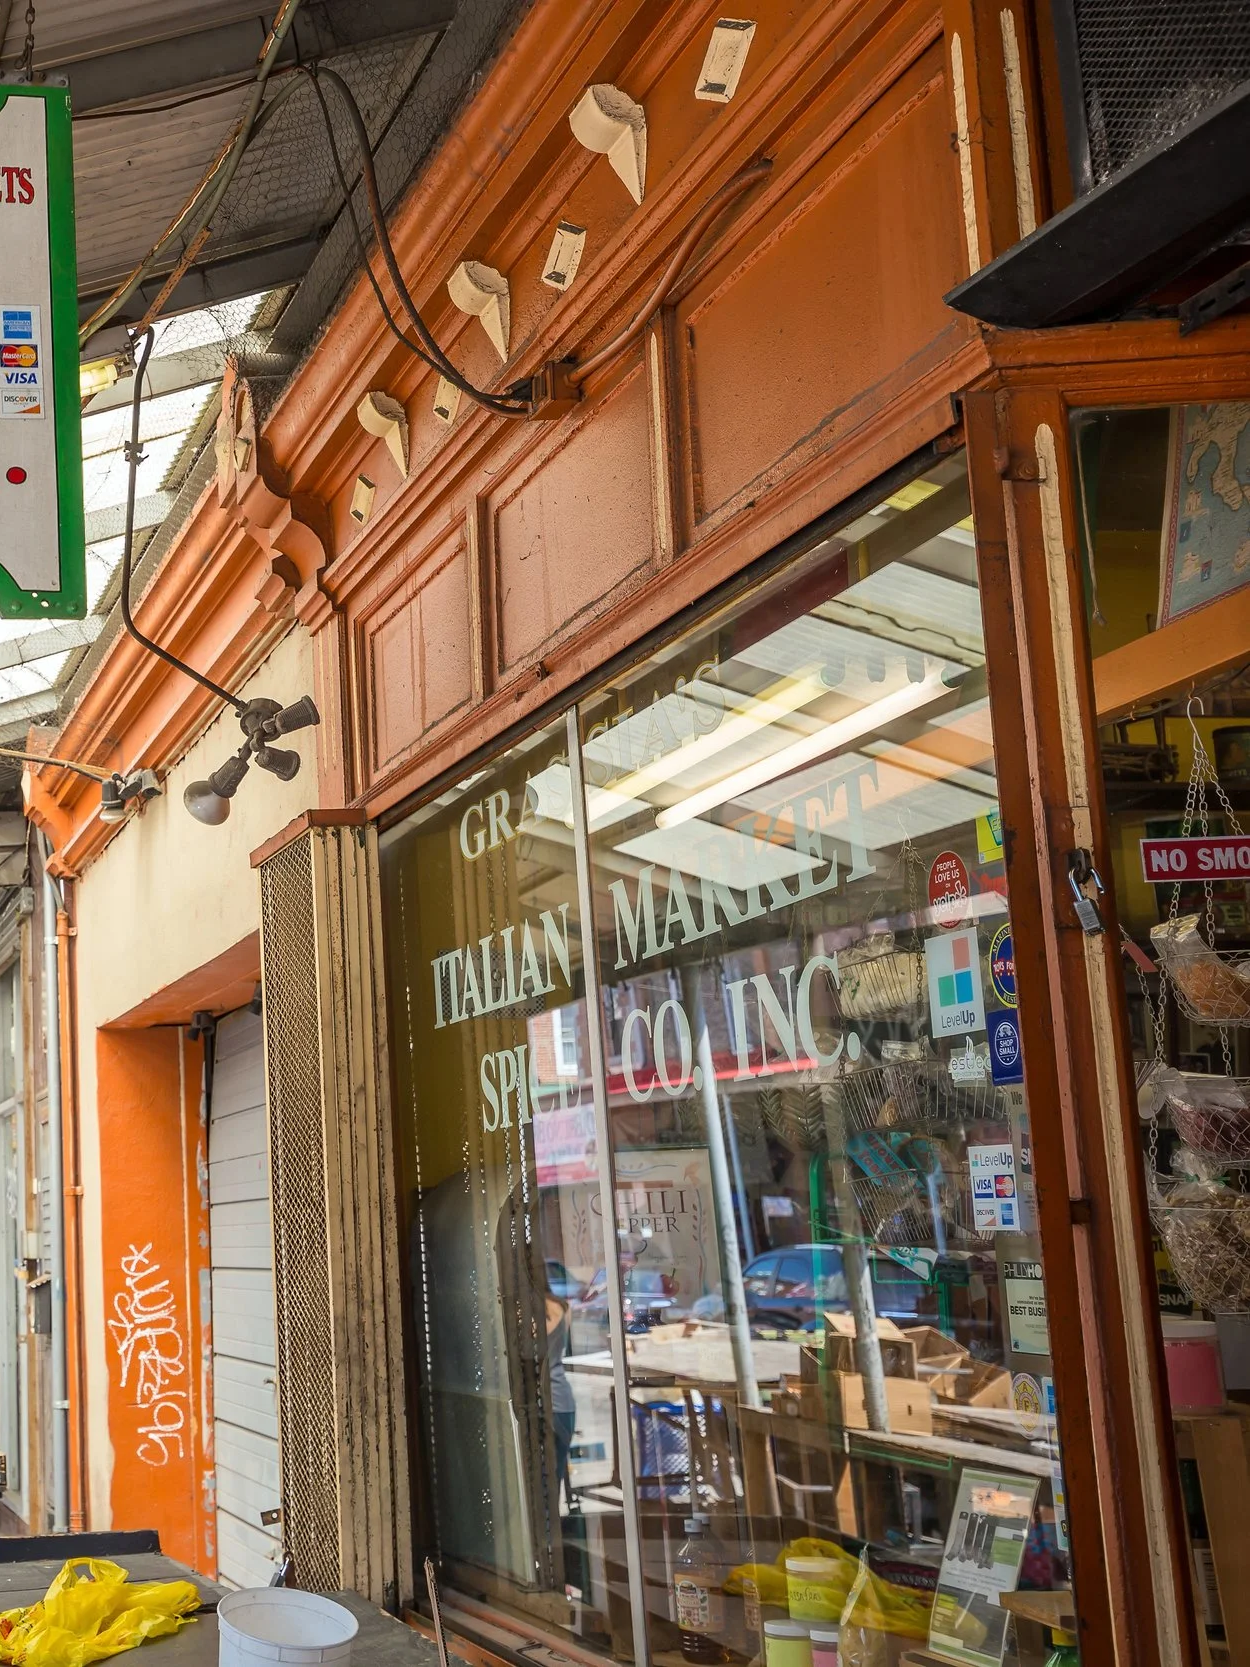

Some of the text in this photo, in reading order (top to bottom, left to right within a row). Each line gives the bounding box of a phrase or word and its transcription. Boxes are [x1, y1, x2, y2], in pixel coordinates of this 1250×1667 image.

[5, 372, 37, 384] VISA
[3, 395, 38, 403] DISCOVER
[936, 860, 957, 872] PEOPLE
[1150, 849, 1188, 872] NO
[934, 869, 960, 884] LOVE US
[431, 760, 879, 1030] ITALIAN MARKET
[941, 1009, 976, 1029] LevelUp
[621, 999, 703, 1103] CO.
[726, 950, 861, 1083] INC.
[999, 1039, 1014, 1048] SHOP
[998, 1046, 1016, 1056] SMALL
[980, 1152, 1013, 1169] LevelUp
[976, 1178, 992, 1190] VISA
[1010, 1305, 1028, 1316] BEST
